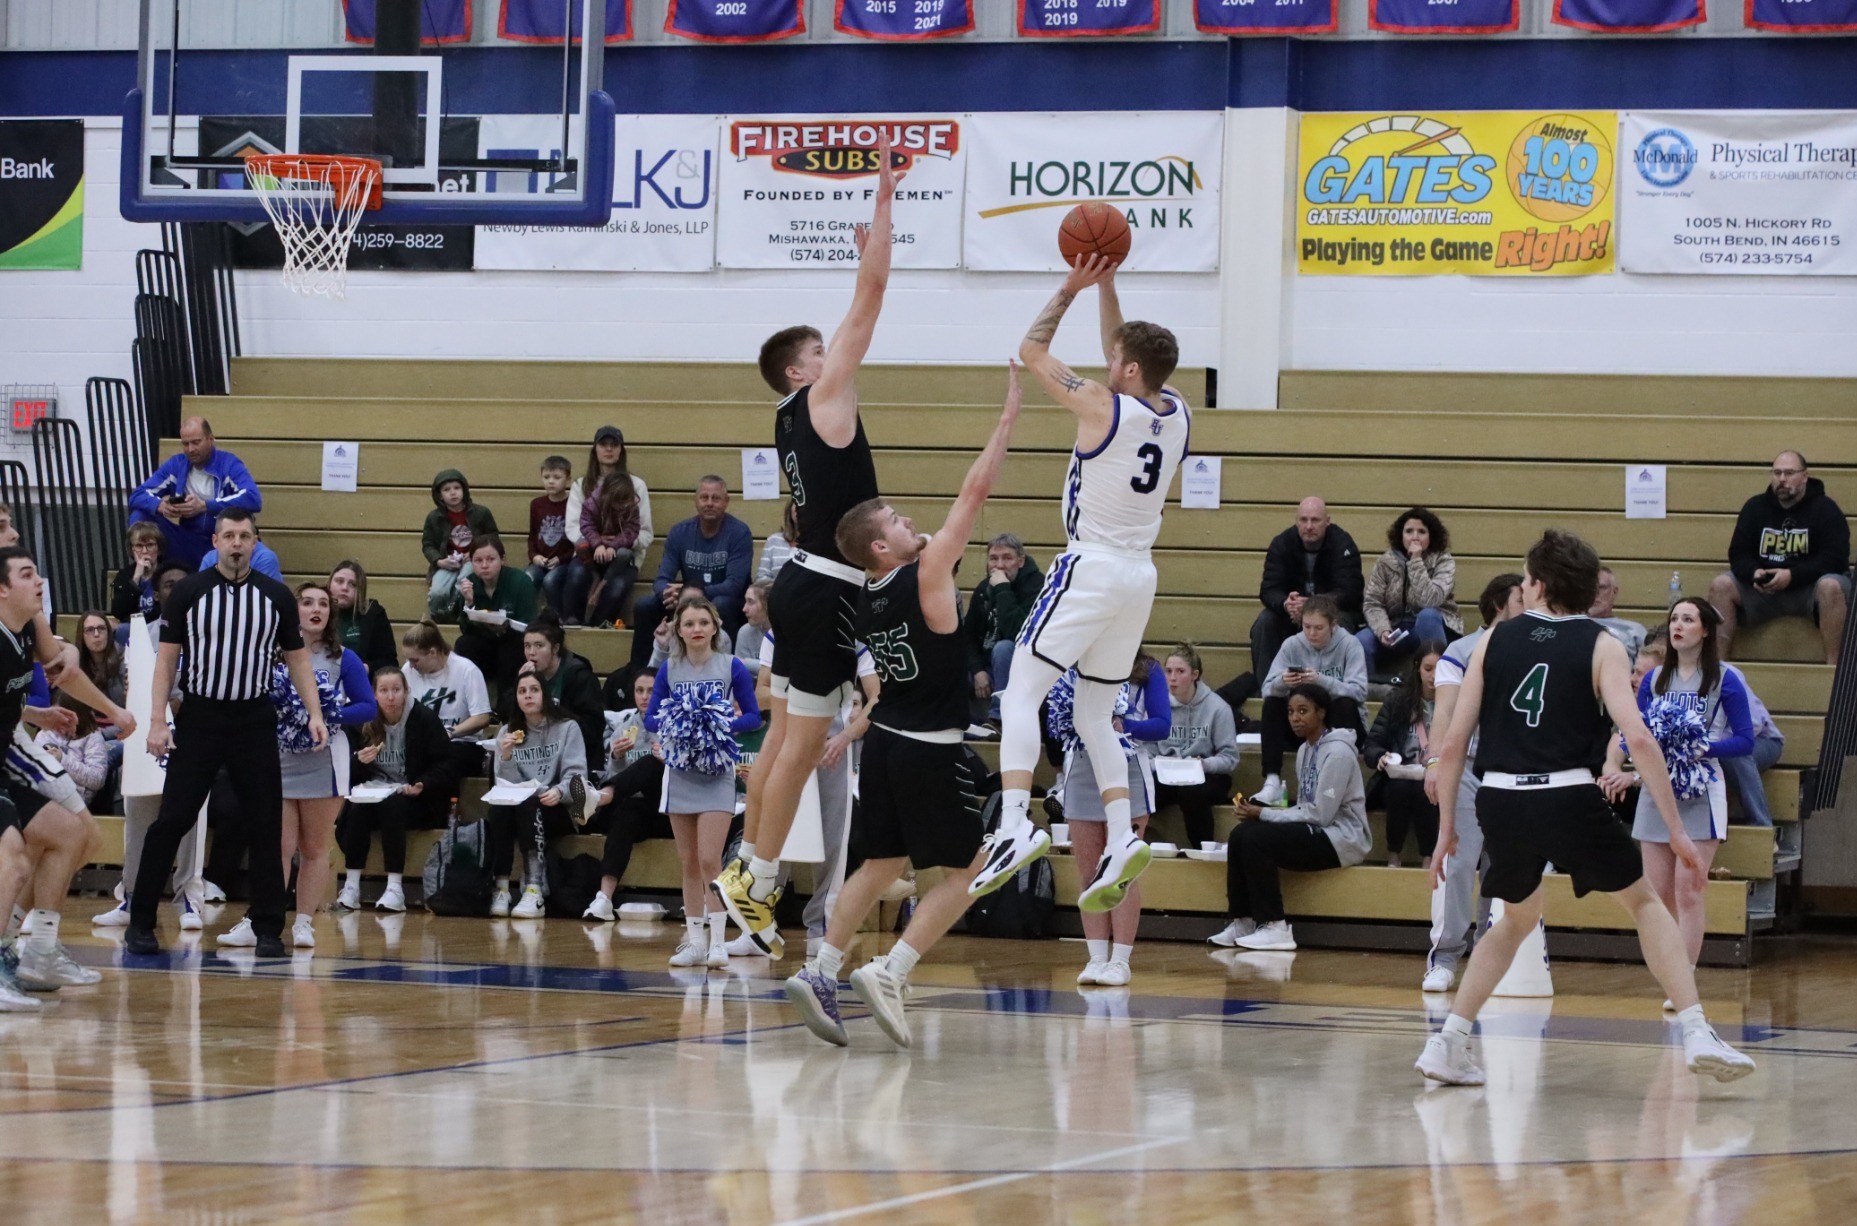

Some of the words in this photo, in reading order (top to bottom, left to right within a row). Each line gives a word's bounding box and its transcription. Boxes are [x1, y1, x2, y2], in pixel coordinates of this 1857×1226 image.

[715, 3, 747, 15] 2002
[865, 0, 897, 13] 2015
[914, 0, 944, 13] 2019
[914, 13, 942, 30] 2021
[1044, 12, 1078, 26] 2019
[1539, 122, 1589, 142] Almost
[736, 122, 953, 162] FIREHOUSE
[804, 149, 882, 171] SUBS
[1523, 134, 1599, 184] 100
[1632, 148, 1699, 164] McDonald
[1711, 142, 1789, 168] Physical
[1, 157, 55, 179] Bank
[1718, 170, 1759, 181] SPORTS
[1760, 170, 1844, 181] REHABILITATION
[1009, 160, 1195, 197] HORIZON
[1303, 154, 1498, 205] GATES
[743, 189, 825, 201] FOUNDED
[833, 189, 855, 201] BY
[864, 189, 944, 201] FEMEN
[1517, 172, 1595, 208] YEARS
[1126, 208, 1194, 229] ANK
[1306, 207, 1493, 225] GATESAUTOMOTIVE.com
[1685, 217, 1722, 229] 1005
[1726, 218, 1742, 229] N.
[1745, 218, 1807, 229] HICKORY
[630, 221, 640, 234] &
[643, 221, 683, 236] Jones,
[685, 221, 709, 234] LLP
[790, 221, 825, 231] 5716
[336, 232, 445, 251] 4)259-8822
[768, 234, 850, 245] MISHAWAKA,
[891, 234, 915, 244] 545
[1494, 220, 1611, 272] Right!
[1673, 234, 1720, 246] SOUTH
[1724, 235, 1767, 247] BEND,
[1771, 235, 1788, 246] IN
[1792, 235, 1840, 246] 46615
[790, 249, 825, 262] (574)
[828, 249, 861, 261] 204-
[1302, 237, 1385, 266] Playing
[1390, 237, 1426, 262] the
[1430, 237, 1494, 262] Game
[1699, 252, 1738, 265] (574)
[1741, 253, 1813, 264] 233-5754
[13, 401, 48, 428] EXIT
[1129, 442, 1164, 495] 3
[685, 550, 729, 568] BUTLER
[1509, 662, 1550, 728] 4
